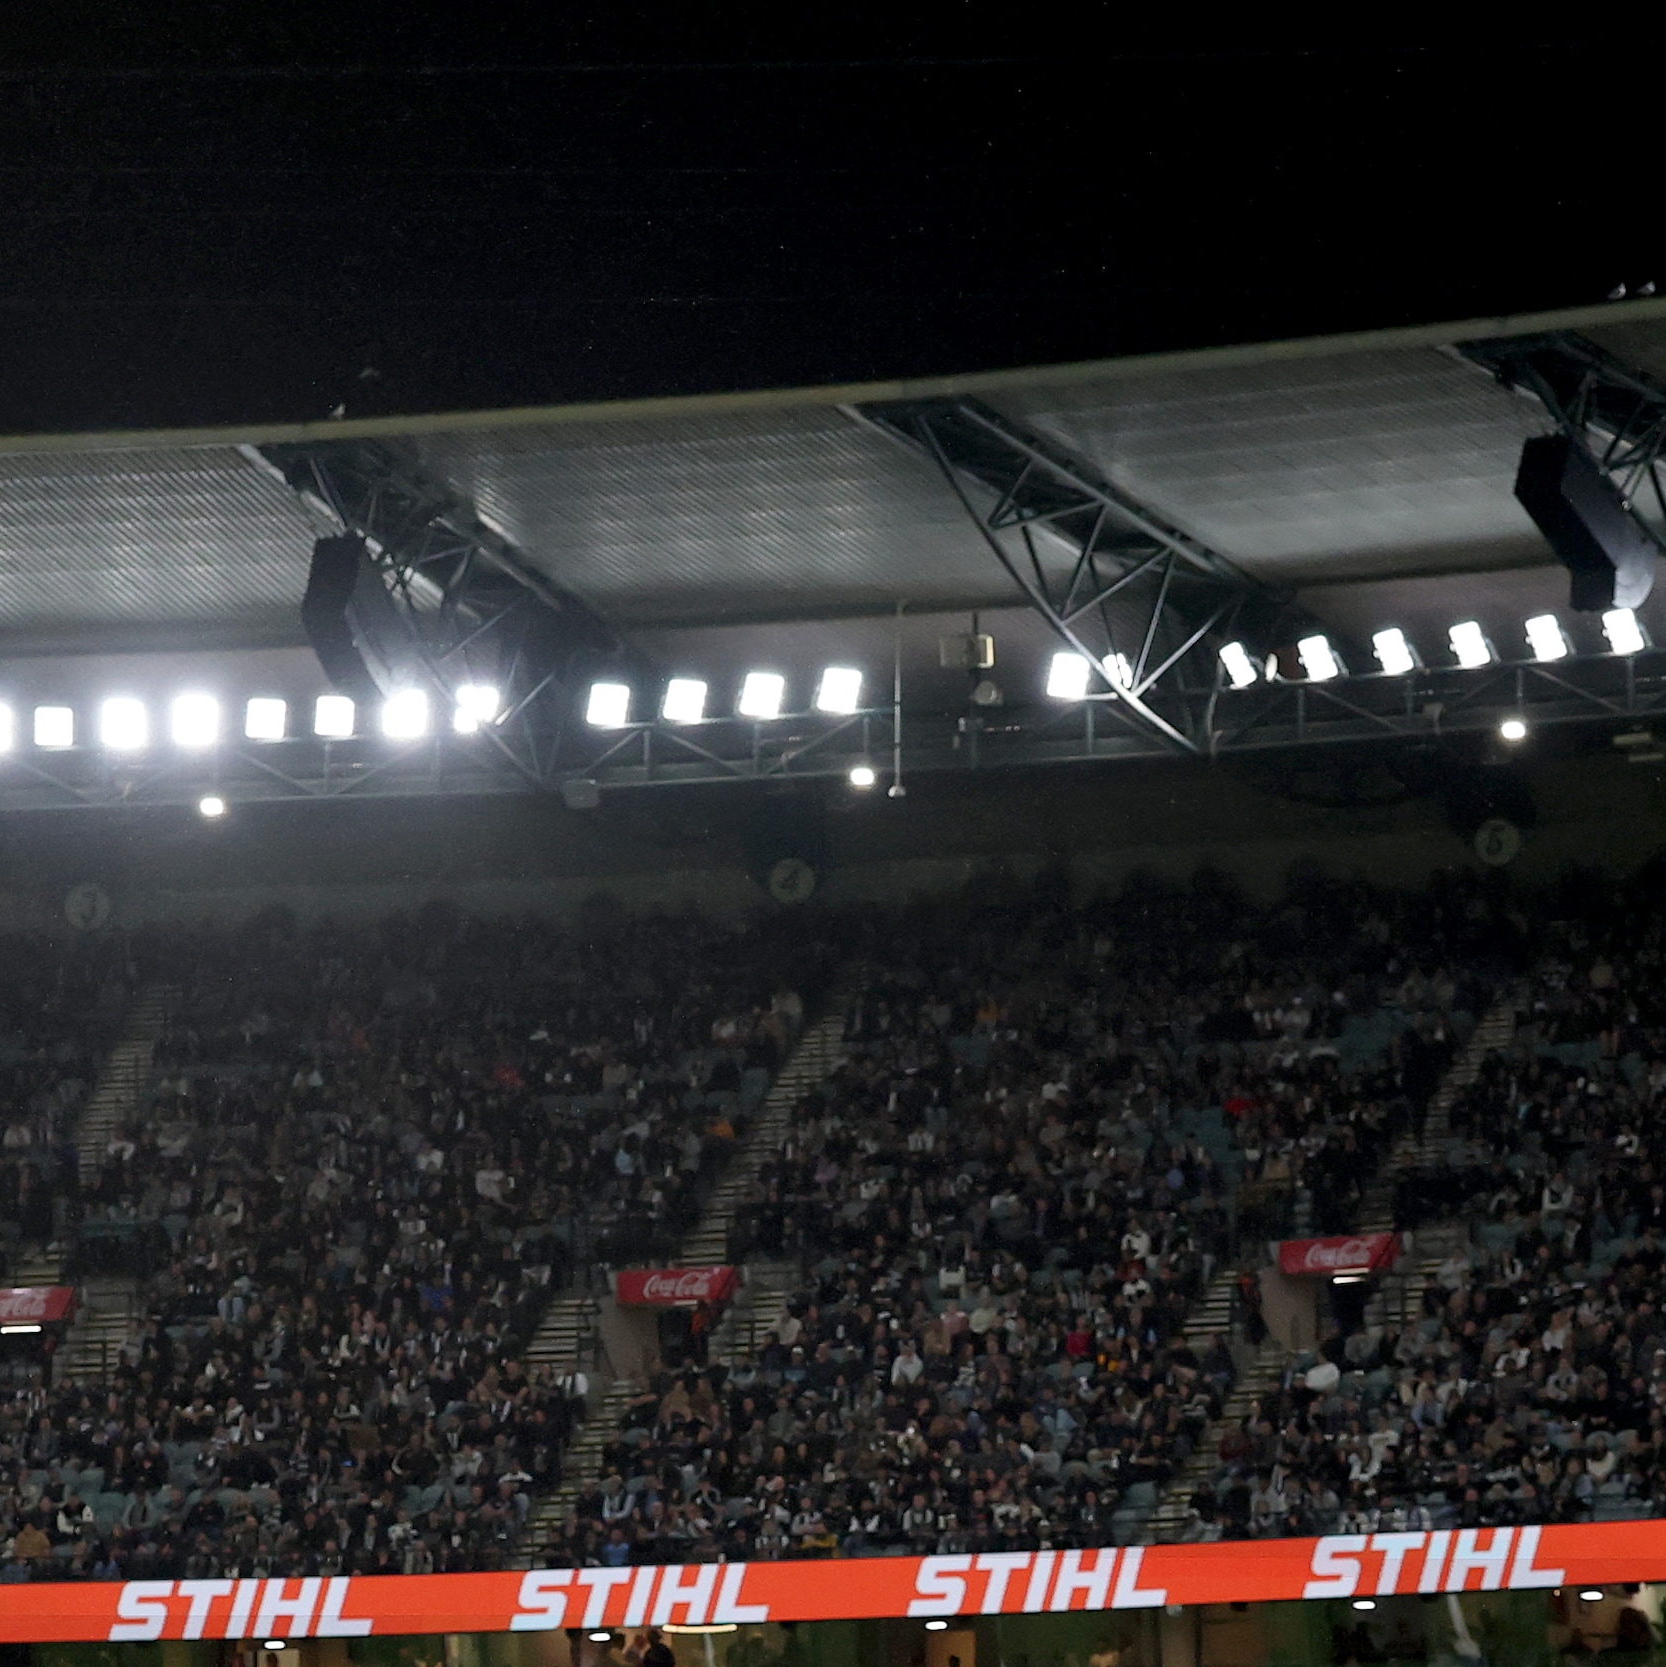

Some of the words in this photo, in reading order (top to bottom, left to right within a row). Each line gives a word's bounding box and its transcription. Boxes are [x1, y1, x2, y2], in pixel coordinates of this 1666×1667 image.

[110, 1577, 372, 1640] STIHL
[510, 1563, 768, 1633] STIHL
[907, 1547, 1166, 1616] STIHL
[1304, 1526, 1564, 1598] STIHL
